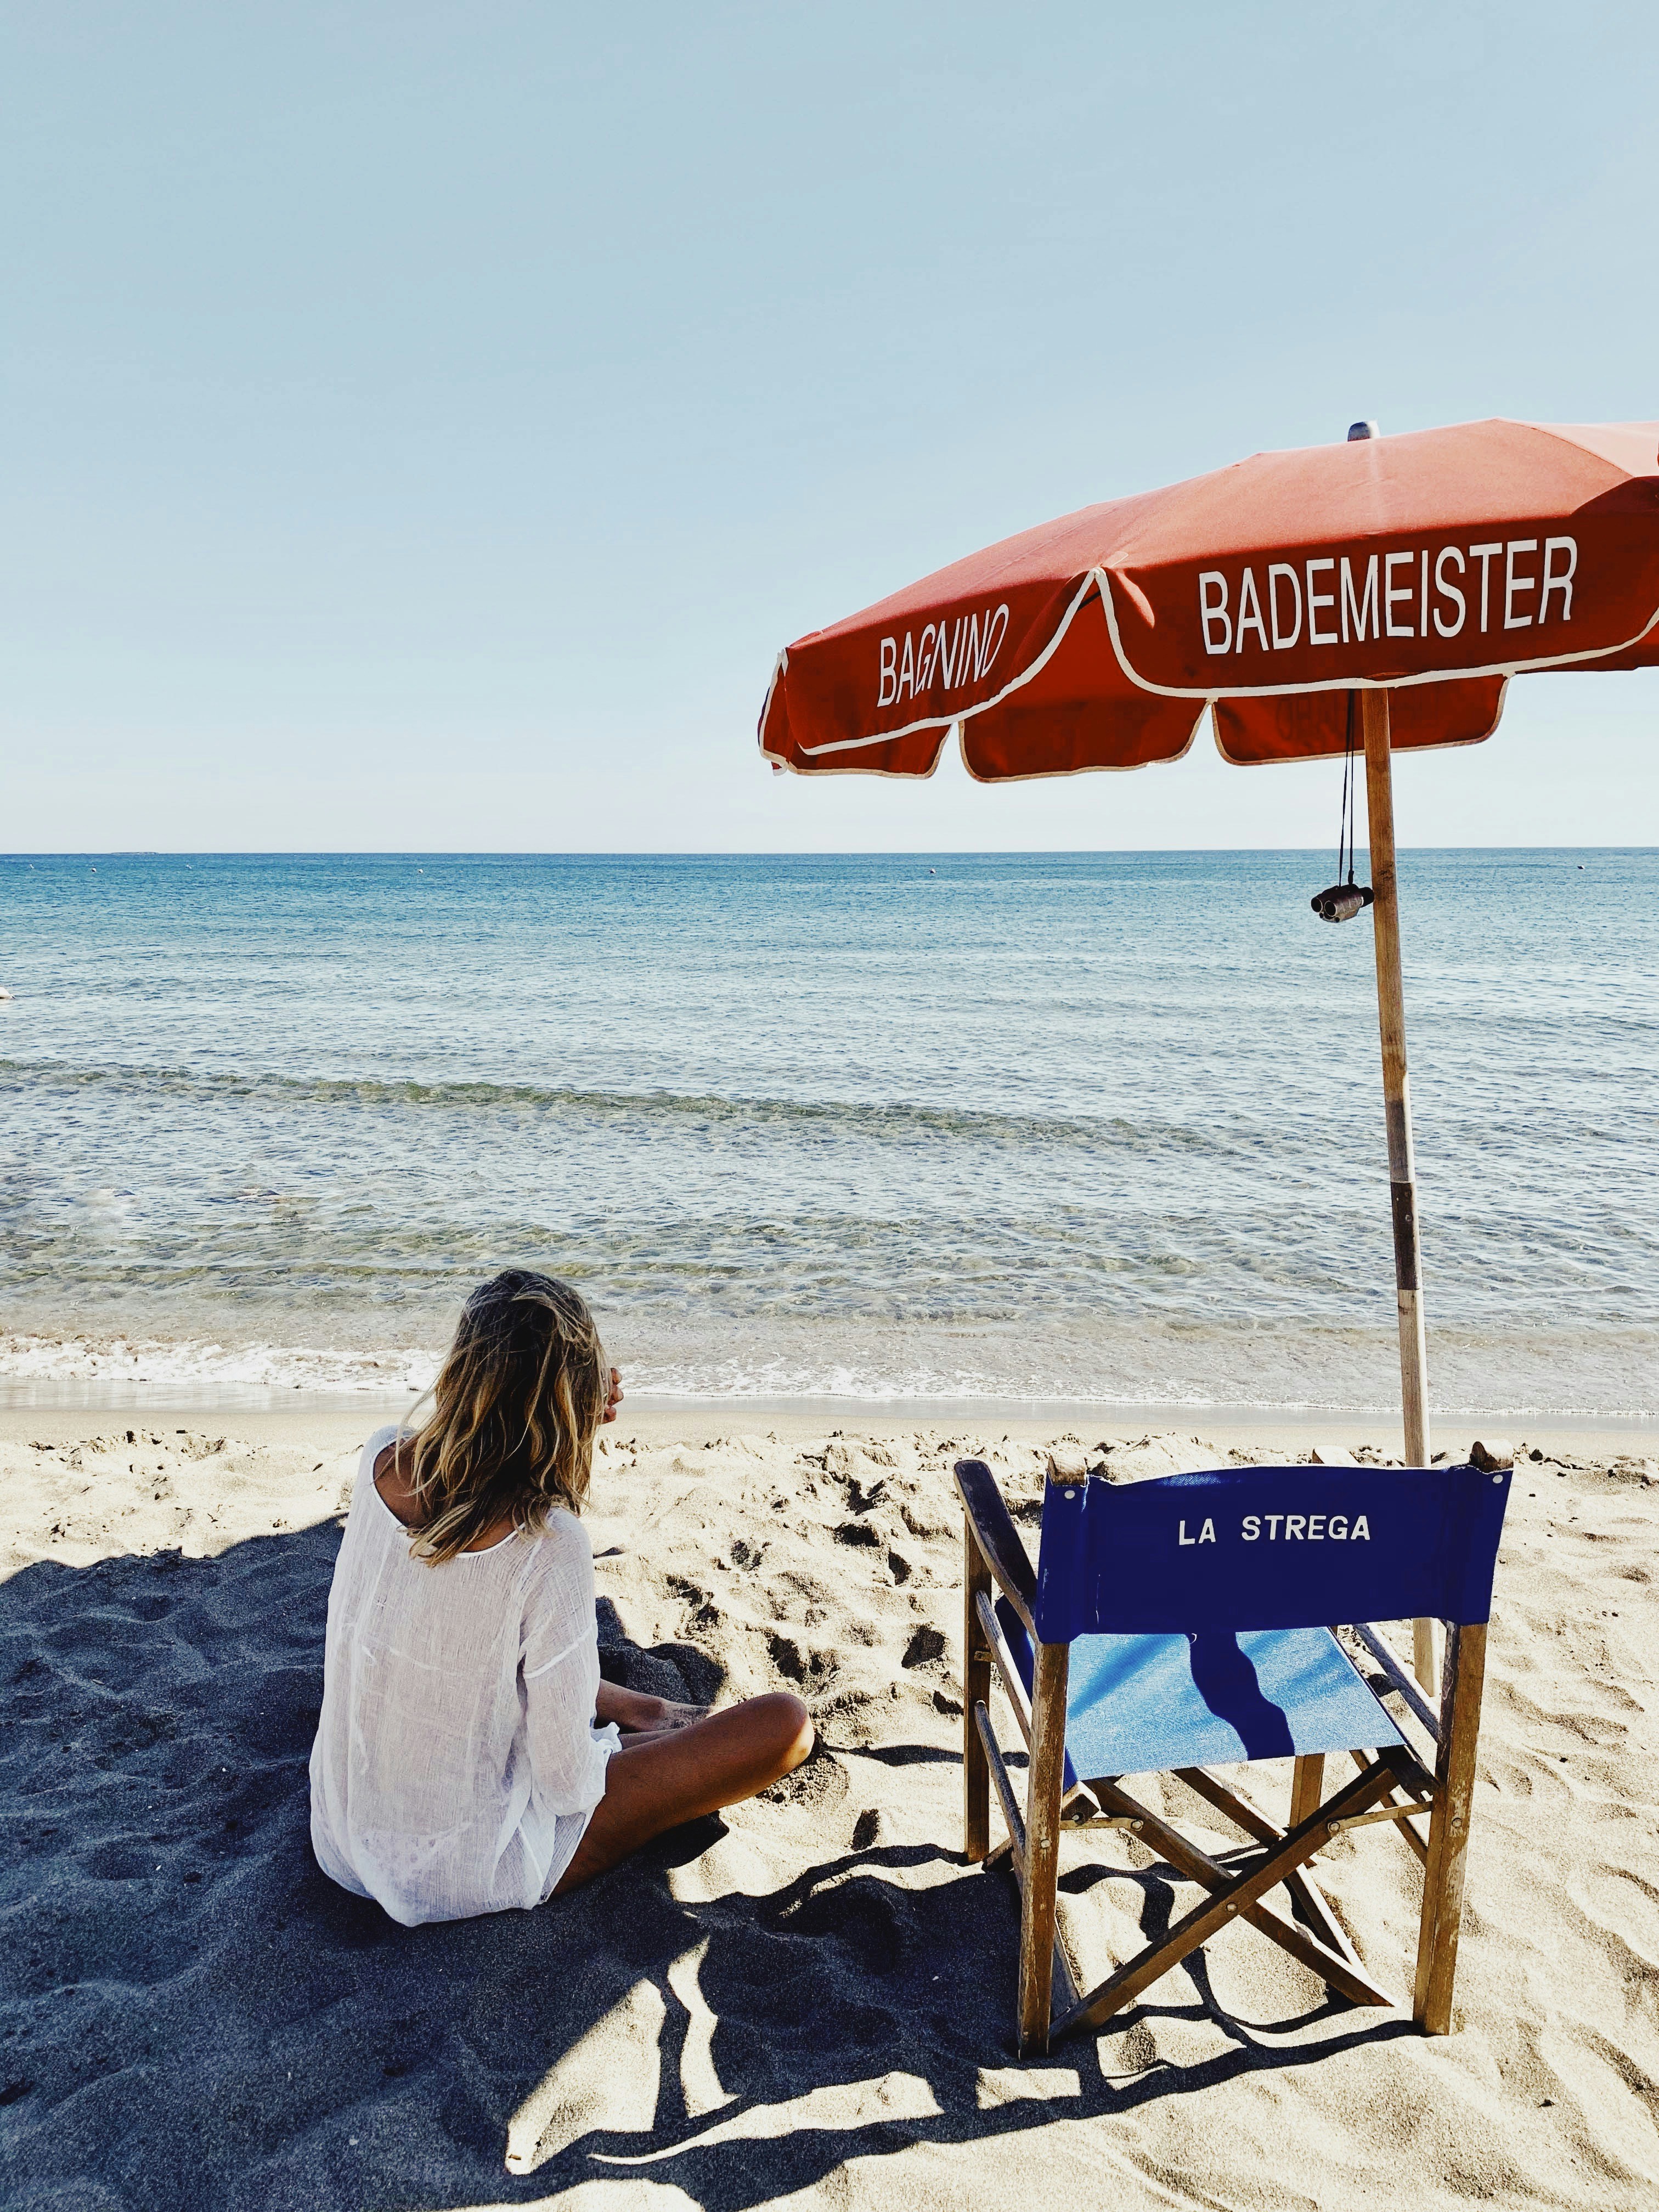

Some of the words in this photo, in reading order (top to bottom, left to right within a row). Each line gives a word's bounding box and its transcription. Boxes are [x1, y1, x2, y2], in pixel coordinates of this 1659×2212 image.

[1198, 535, 1578, 655] BADEMEISTER
[876, 603, 1010, 708] BAGNINO
[1178, 1518, 1217, 1546] LA
[1241, 1515, 1371, 1541] STREGA
